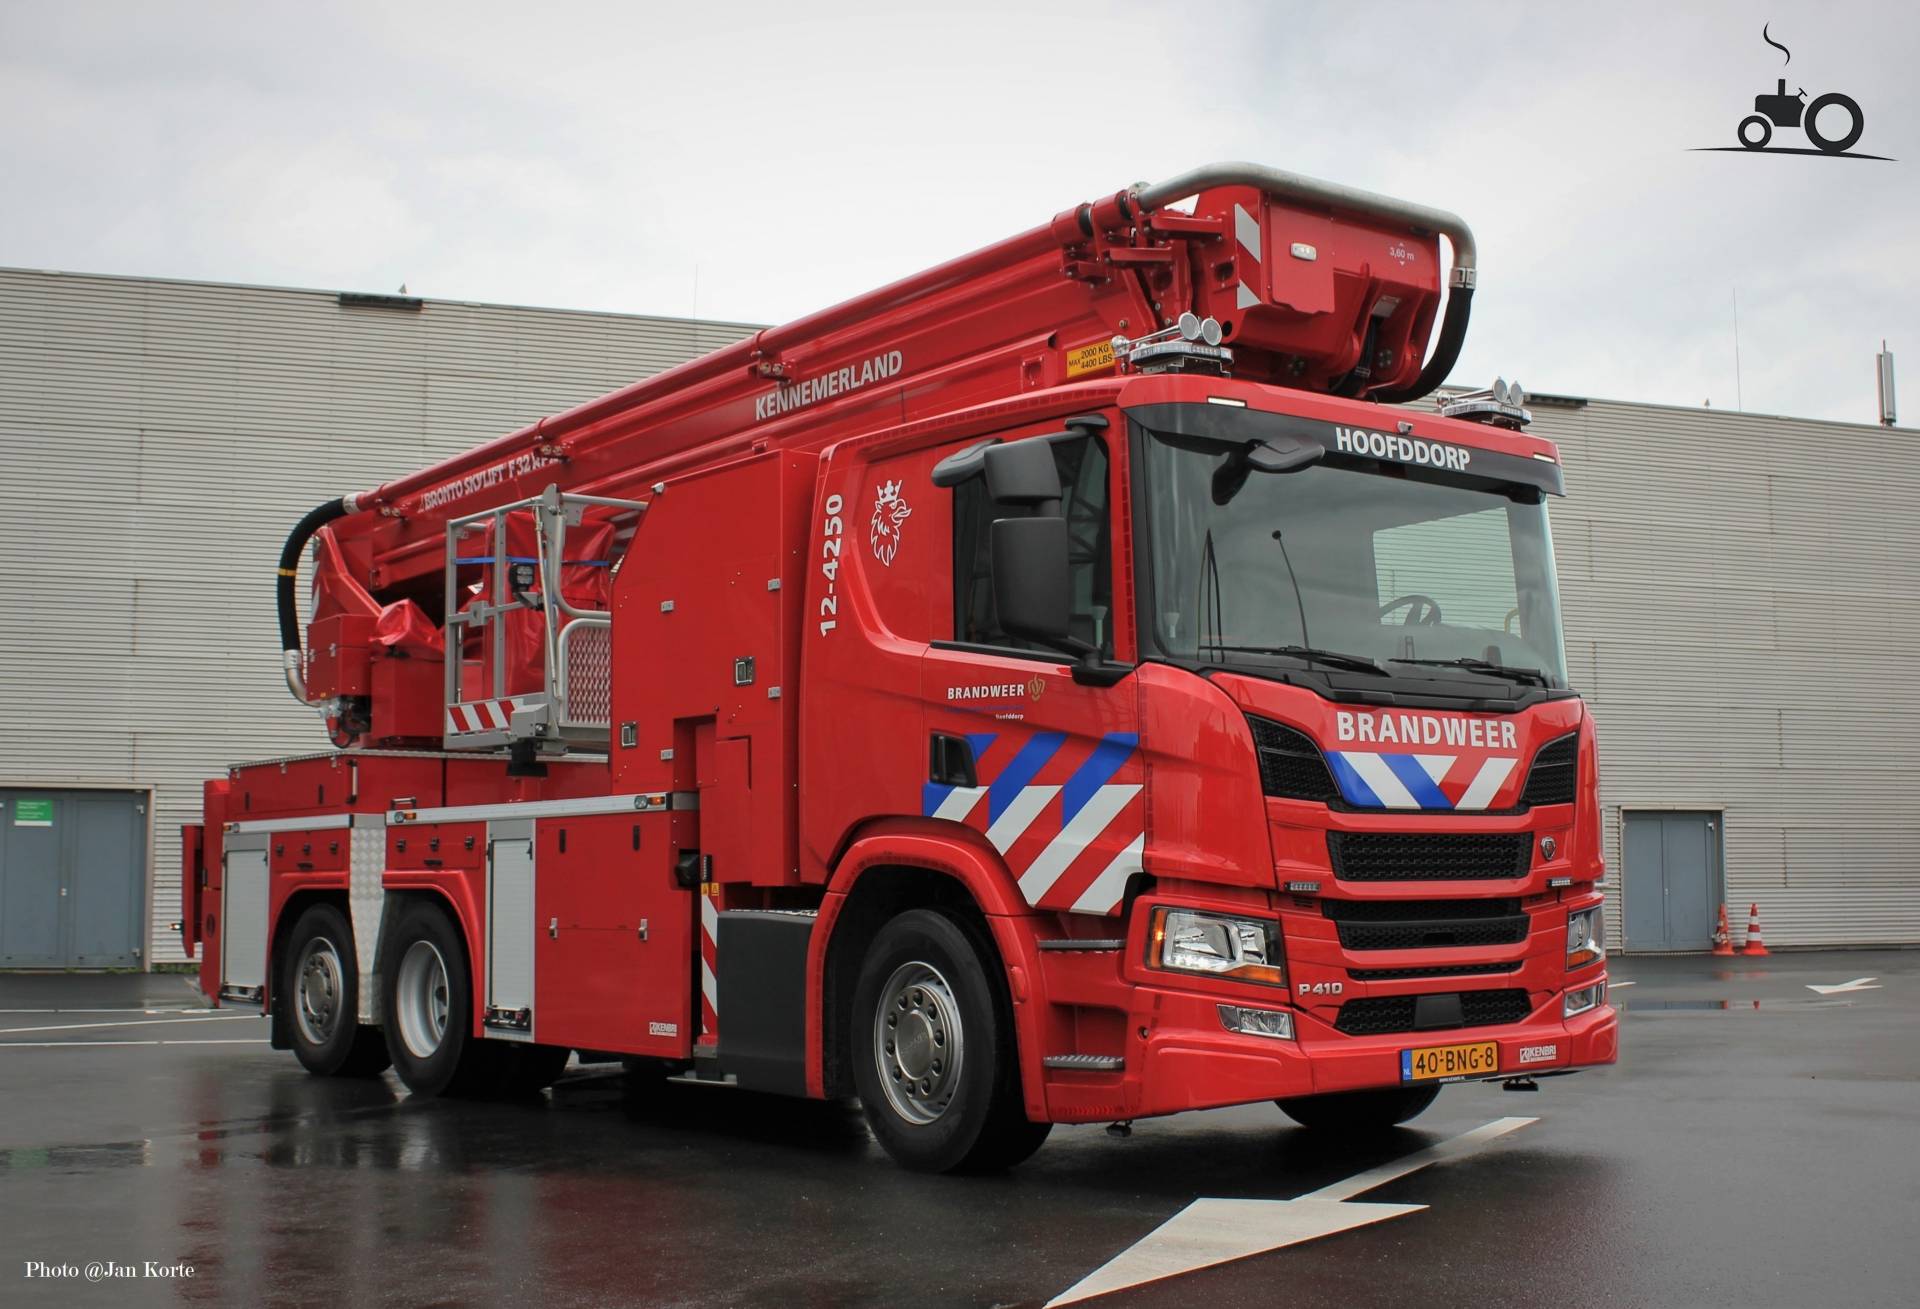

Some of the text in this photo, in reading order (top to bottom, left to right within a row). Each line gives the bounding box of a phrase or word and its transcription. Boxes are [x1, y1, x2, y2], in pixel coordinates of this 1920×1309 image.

[1407, 253, 1415, 261] m
[1081, 343, 1109, 359] 2000 KG
[1081, 353, 1113, 369] 4400 LBS
[755, 350, 904, 421] KENNEMERLAND
[1335, 426, 1471, 471] HOOFDDORP
[424, 480, 464, 512] BRONTO
[464, 464, 505, 496] SKYLIFT
[819, 494, 843, 638] 12-4250
[947, 683, 1025, 700] BRANDWEER
[1336, 711, 1518, 749] BRANDWEER
[1298, 982, 1343, 996] P 410
[1415, 1046, 1495, 1075] 40-BNG-8
